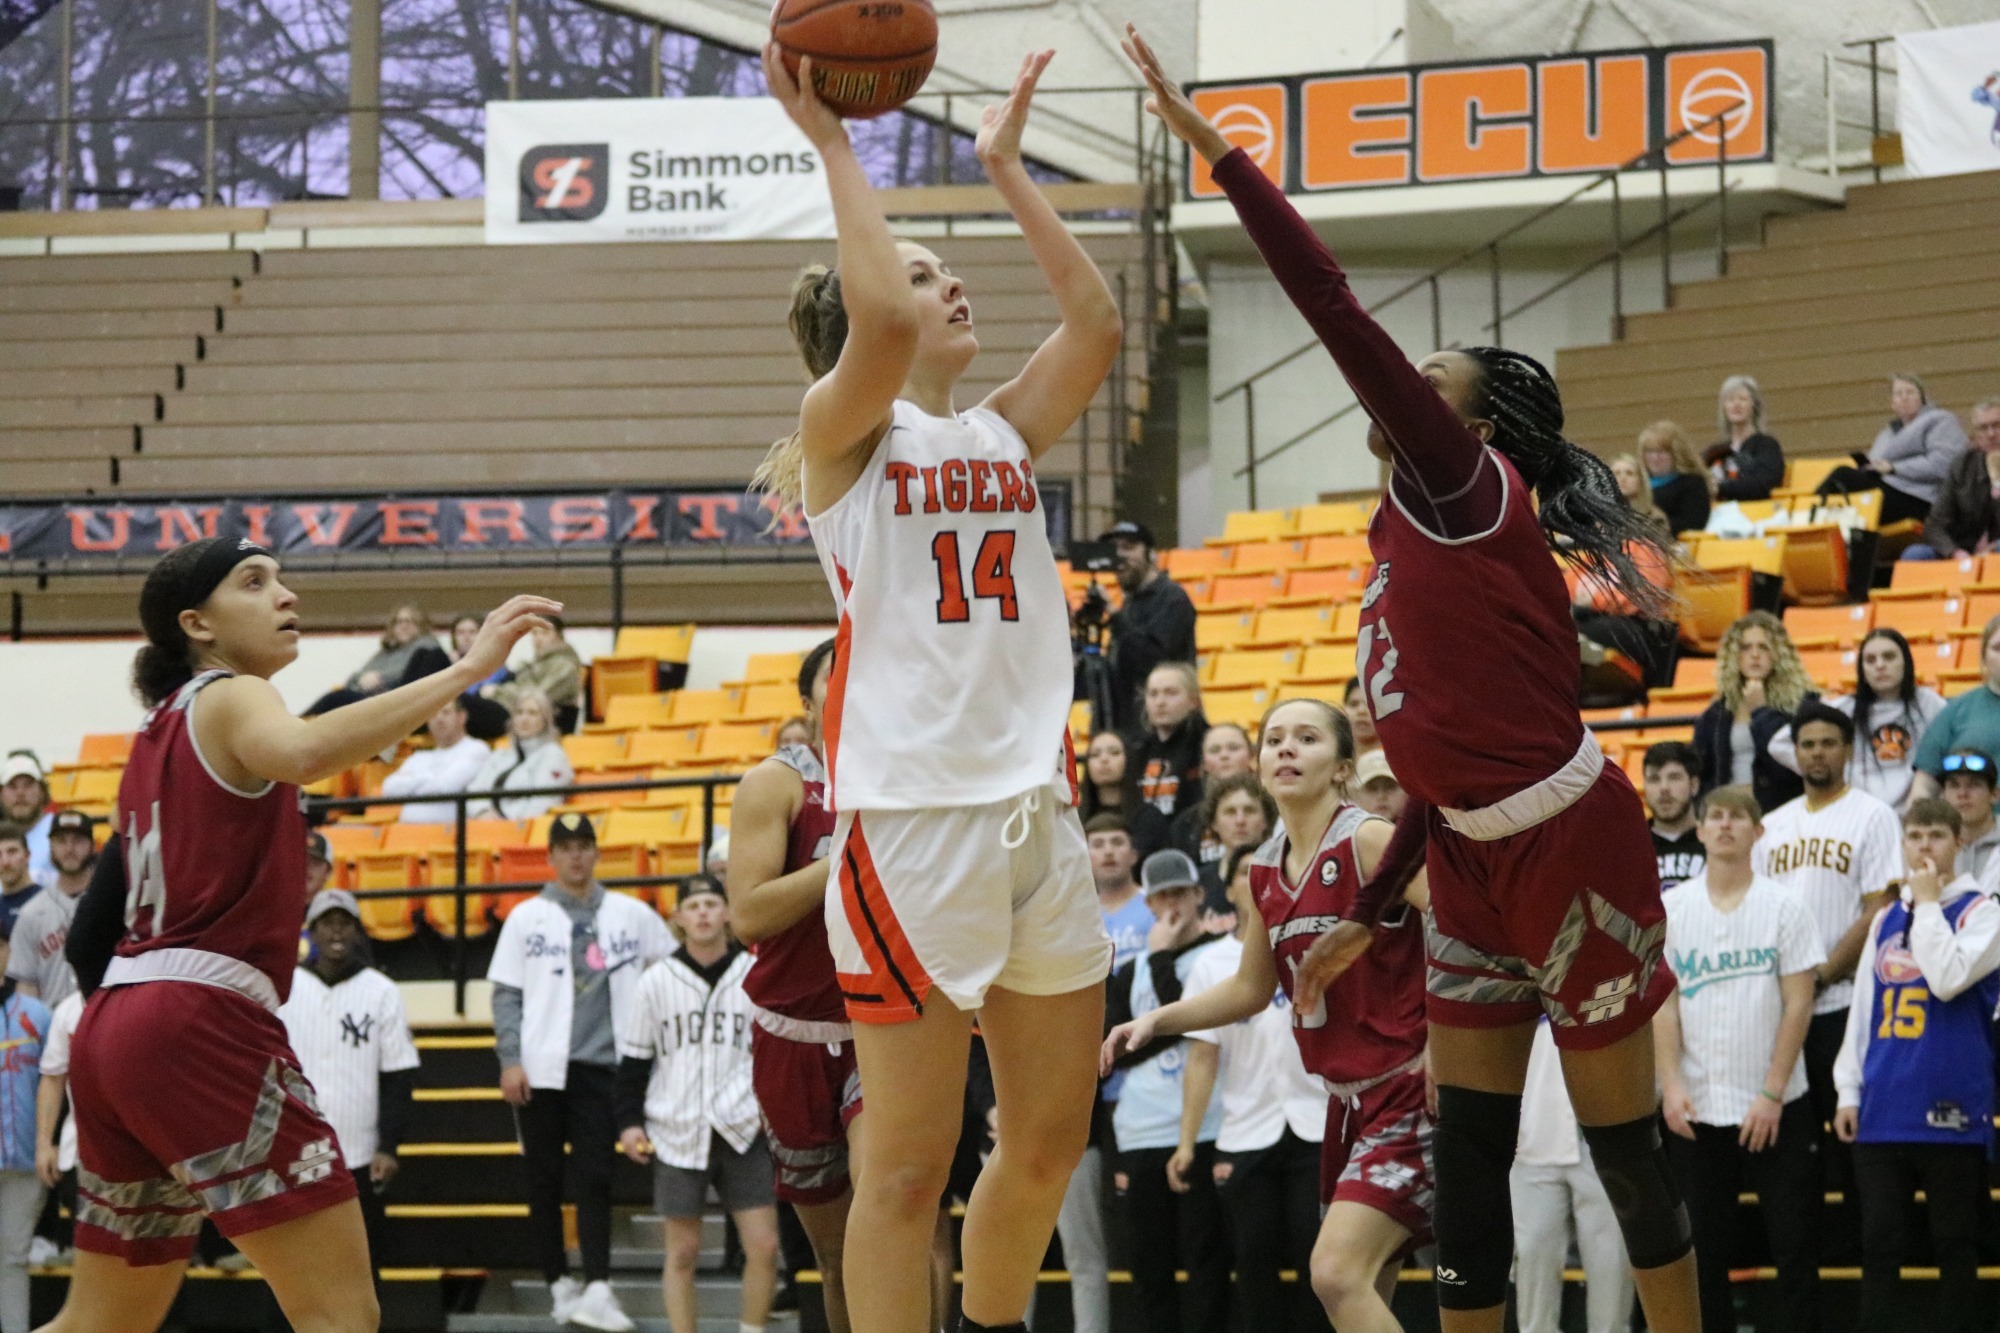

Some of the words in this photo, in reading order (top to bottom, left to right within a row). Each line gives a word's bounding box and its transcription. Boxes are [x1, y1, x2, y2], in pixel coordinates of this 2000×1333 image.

[1301, 54, 1649, 191] ECU
[628, 149, 816, 179] Simmons
[626, 182, 728, 213] Bank
[886, 458, 1037, 516] TIGERS
[931, 529, 1020, 624] 14
[1877, 986, 1929, 1040] 15
